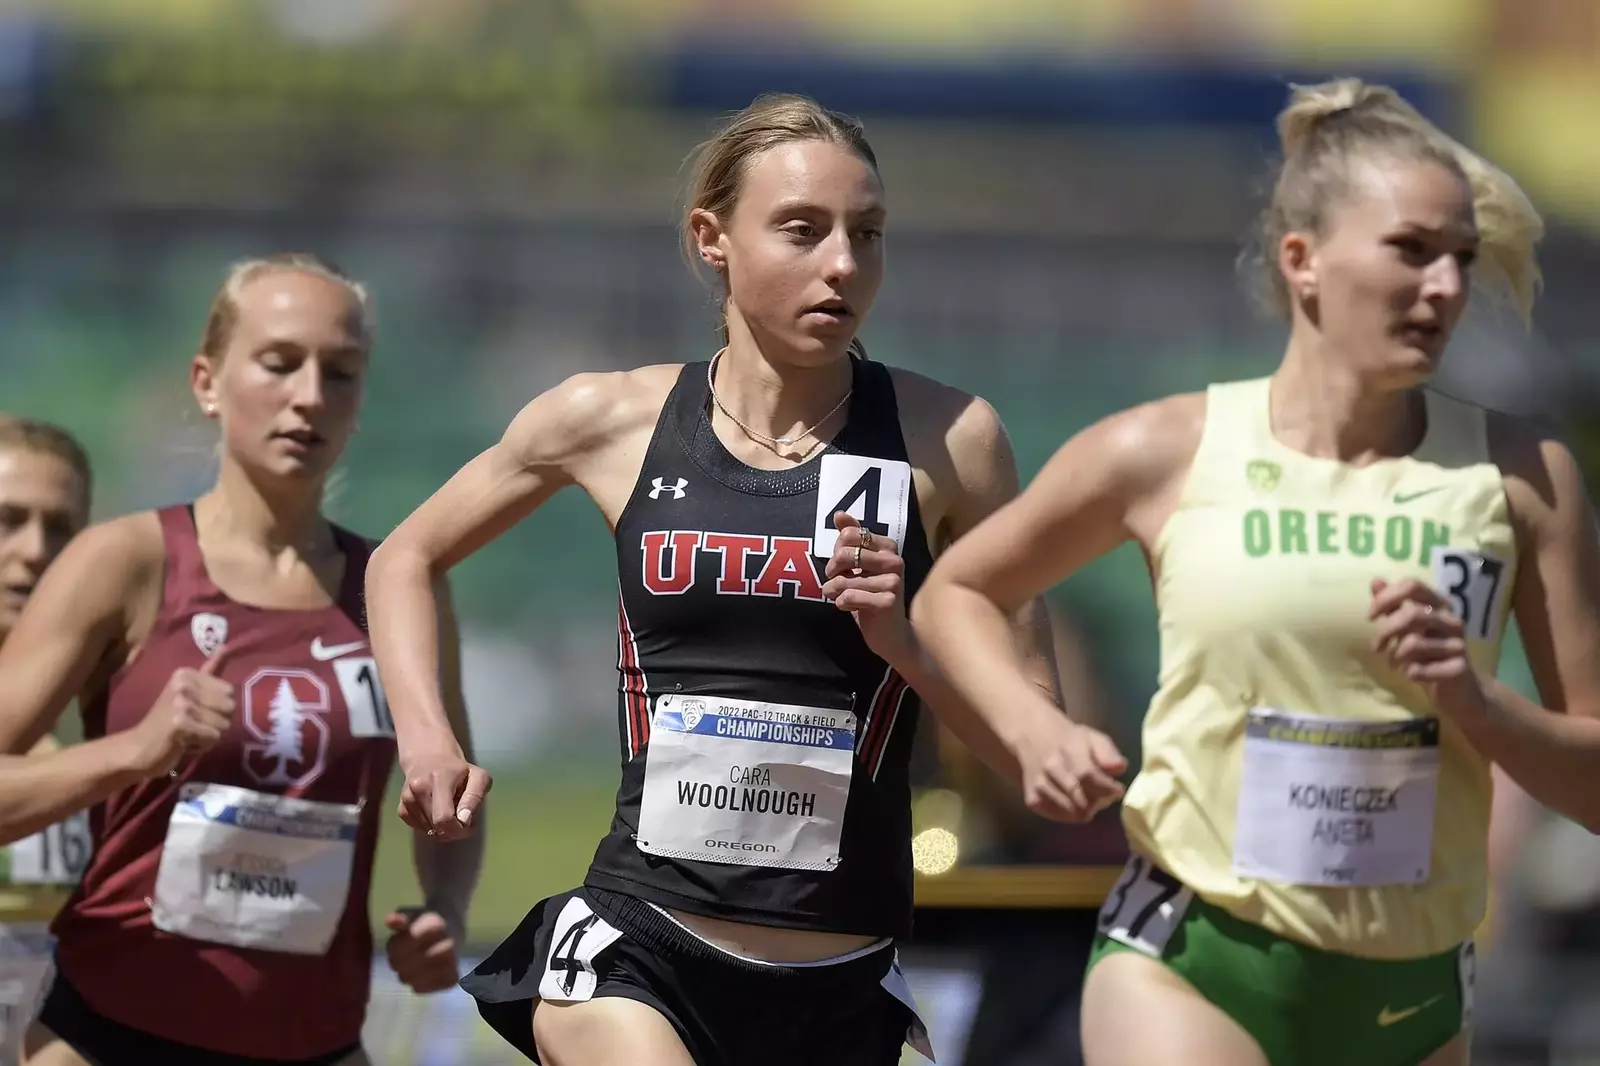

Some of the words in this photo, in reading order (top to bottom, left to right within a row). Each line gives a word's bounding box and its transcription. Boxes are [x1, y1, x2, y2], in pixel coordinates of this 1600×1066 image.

[825, 466, 889, 538] 4
[1243, 509, 1450, 567] OREGON
[641, 531, 836, 604] UTA
[1444, 555, 1503, 638] 37
[716, 718, 834, 746] CHAMPIONSHIPS
[718, 706, 740, 717] 2022
[742, 709, 773, 720] PAC-12
[776, 712, 802, 724] TRACK
[804, 715, 810, 724] &
[812, 716, 836, 727] FIELD
[678, 781, 816, 816] WOOLNOUGH
[730, 766, 771, 786] CARA
[1288, 784, 1399, 813] KONIECZEK
[705, 839, 776, 853] OREGON
[1102, 856, 1184, 939] 37
[550, 912, 601, 993] 4
